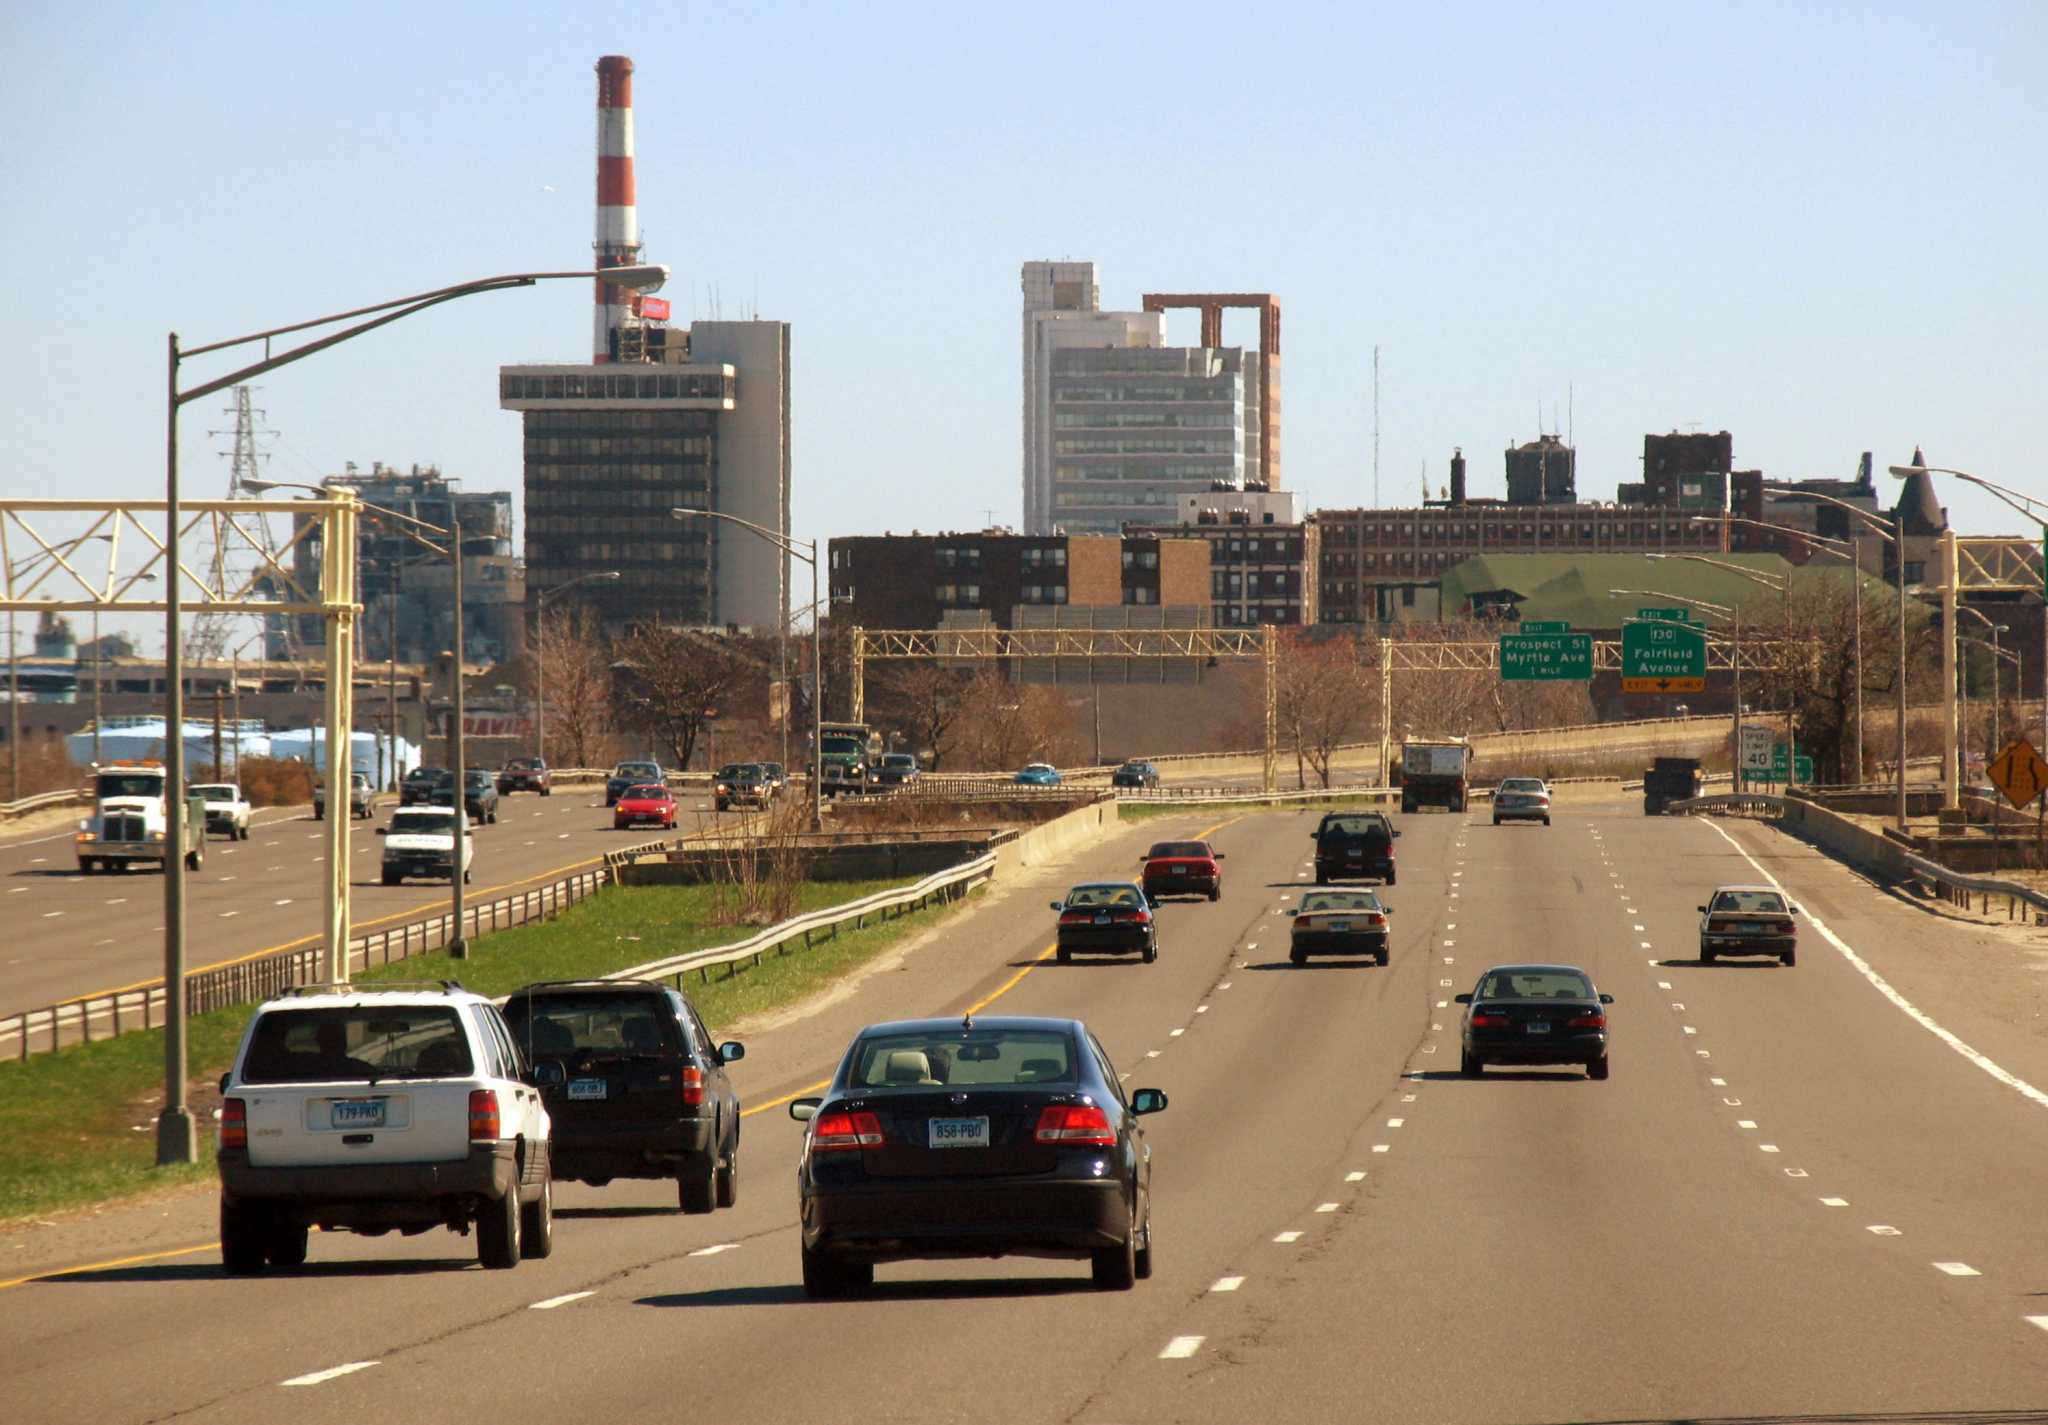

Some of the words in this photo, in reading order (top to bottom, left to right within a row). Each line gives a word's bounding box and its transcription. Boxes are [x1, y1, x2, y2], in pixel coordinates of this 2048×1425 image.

[1677, 611, 1685, 620] 2
[1652, 628, 1673, 640] 130
[1505, 640, 1561, 652] Prospect
[1572, 639, 1586, 650] St
[1506, 653, 1551, 666] Myrtle
[1561, 653, 1586, 663] Ave
[1634, 648, 1693, 659] Fairfield
[1639, 663, 1689, 673] Avenue
[1748, 753, 1768, 766] 40
